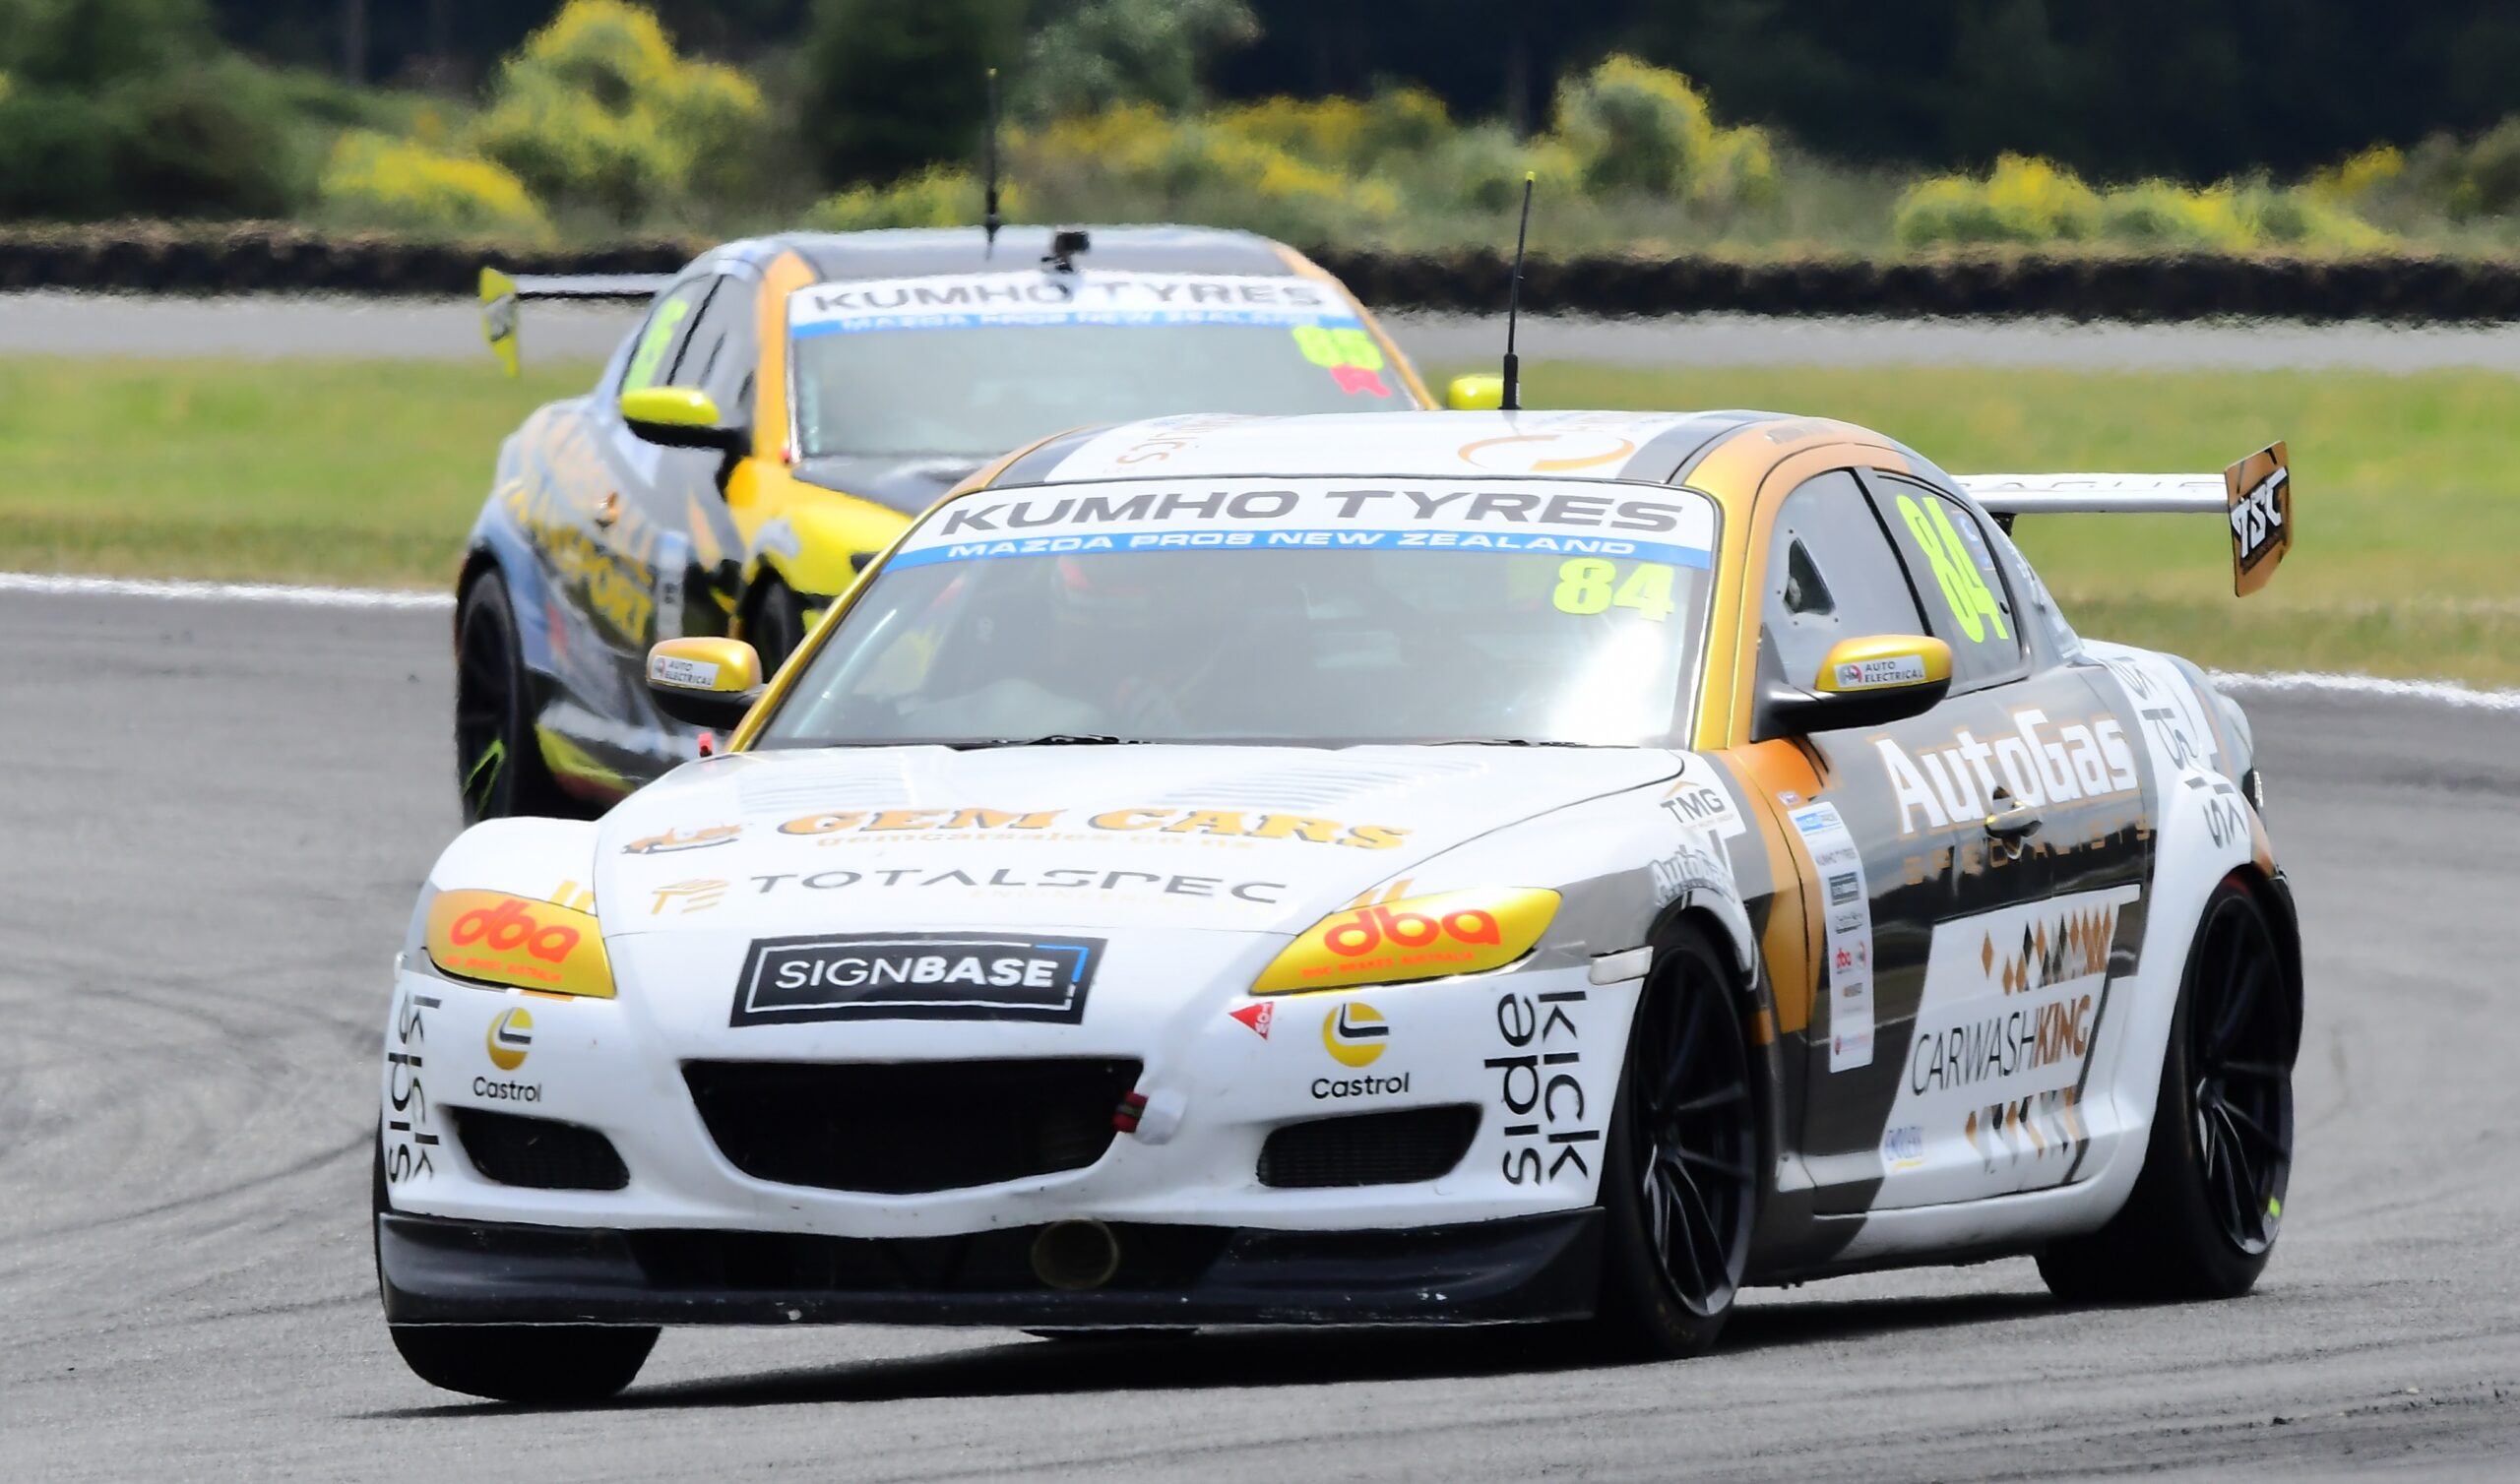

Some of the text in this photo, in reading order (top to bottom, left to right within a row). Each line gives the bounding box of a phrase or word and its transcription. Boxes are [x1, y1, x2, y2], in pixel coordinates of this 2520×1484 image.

[814, 280, 1322, 312] KUMHO TYRES
[940, 490, 1682, 536] KUMHO TYRES
[947, 534, 1112, 558] MAZDA
[1268, 532, 1385, 546] NEW
[1397, 531, 1635, 555] ZEALAND
[1552, 557, 1674, 623] 84
[1896, 495, 2009, 644] 84
[1864, 669, 1923, 683] ELECTRICAL
[1865, 660, 1896, 671] AUTO
[1875, 709, 2138, 835] AutoGas
[1660, 788, 1726, 824] TMG
[777, 808, 1415, 850] GEM CARS
[1904, 814, 2151, 886] SPECALISTS
[751, 868, 1287, 904] TOTALSPEC
[449, 899, 580, 963] dba
[1324, 906, 1502, 957] dba
[775, 956, 1059, 990] SIGNBASE
[1255, 1002, 1273, 1035] TOW
[1912, 994, 2091, 1096] CARWASHKING
[472, 1076, 541, 1102] Castrol
[1311, 1073, 1410, 1099] Castrol
[1483, 993, 1543, 1187] epis
[1538, 990, 1601, 1180] kick
